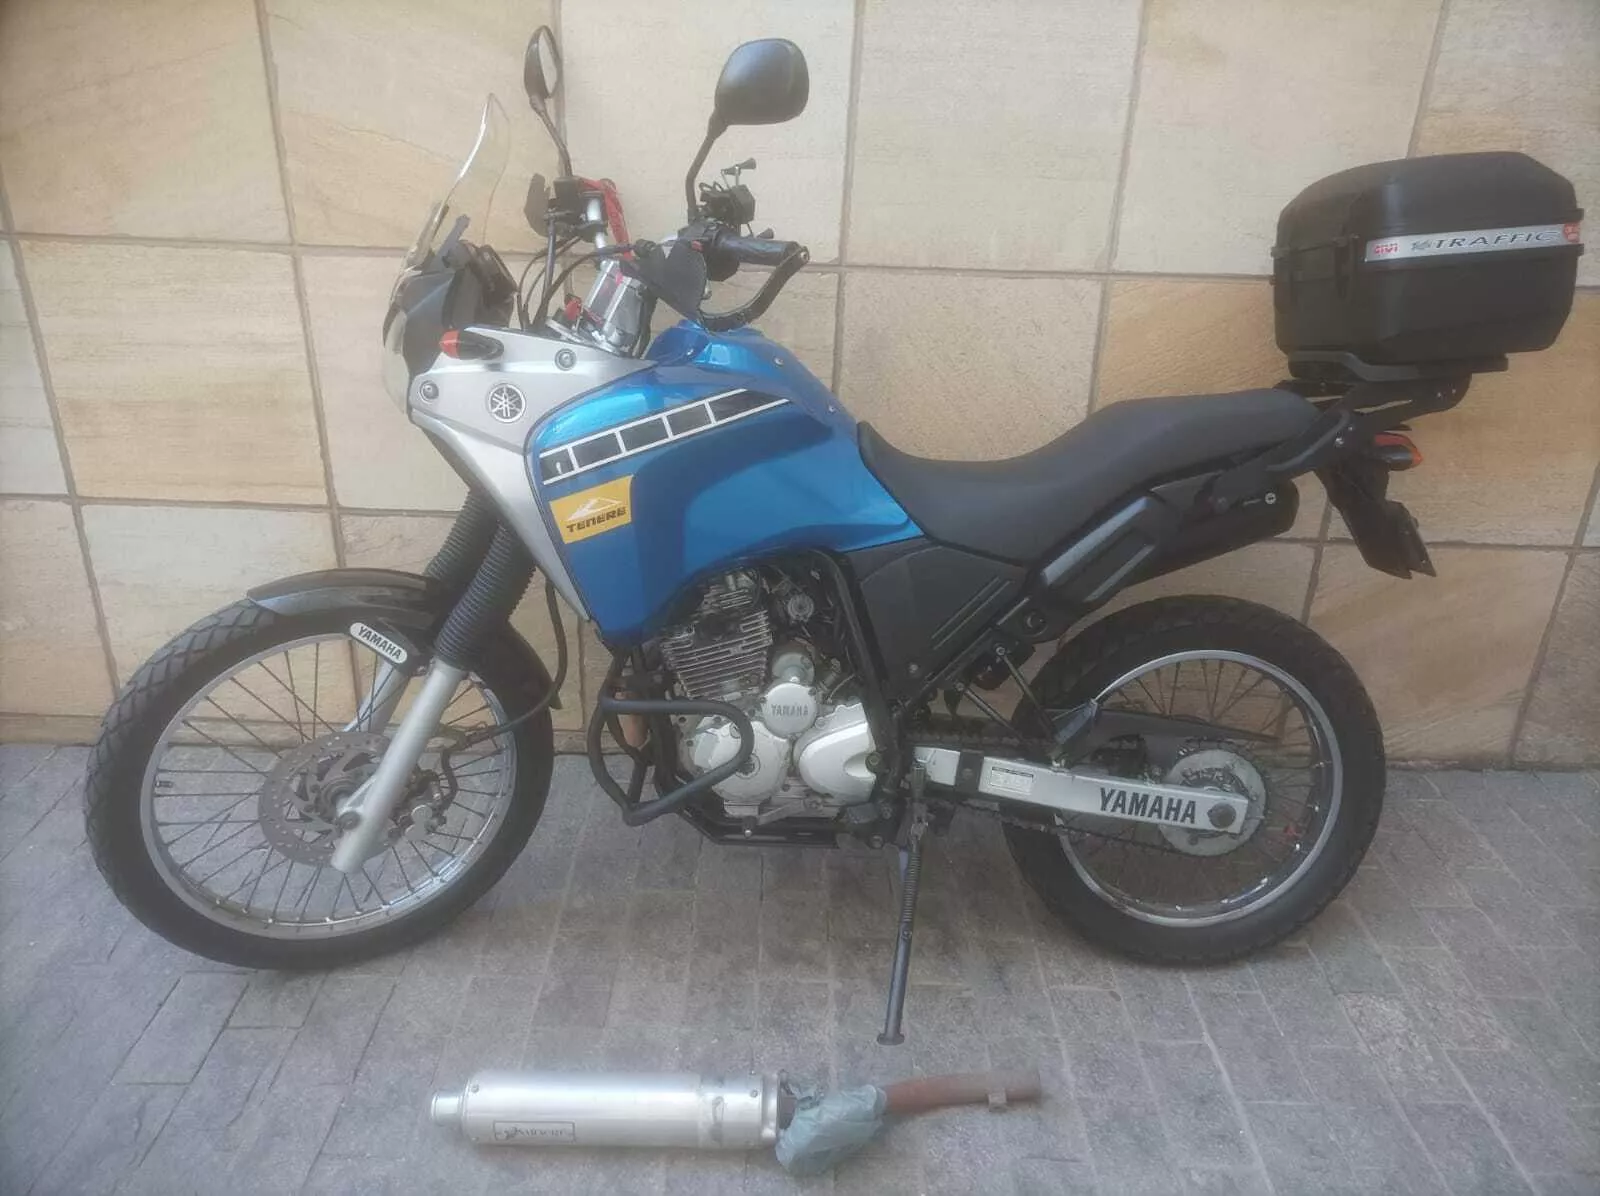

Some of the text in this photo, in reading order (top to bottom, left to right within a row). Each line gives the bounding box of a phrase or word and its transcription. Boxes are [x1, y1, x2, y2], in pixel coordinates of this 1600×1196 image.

[1435, 231, 1560, 249] TRAFFIC
[358, 626, 402, 659] YAMAHA
[770, 703, 809, 717] YAMAHA
[1100, 787, 1196, 824] YAMAHA
